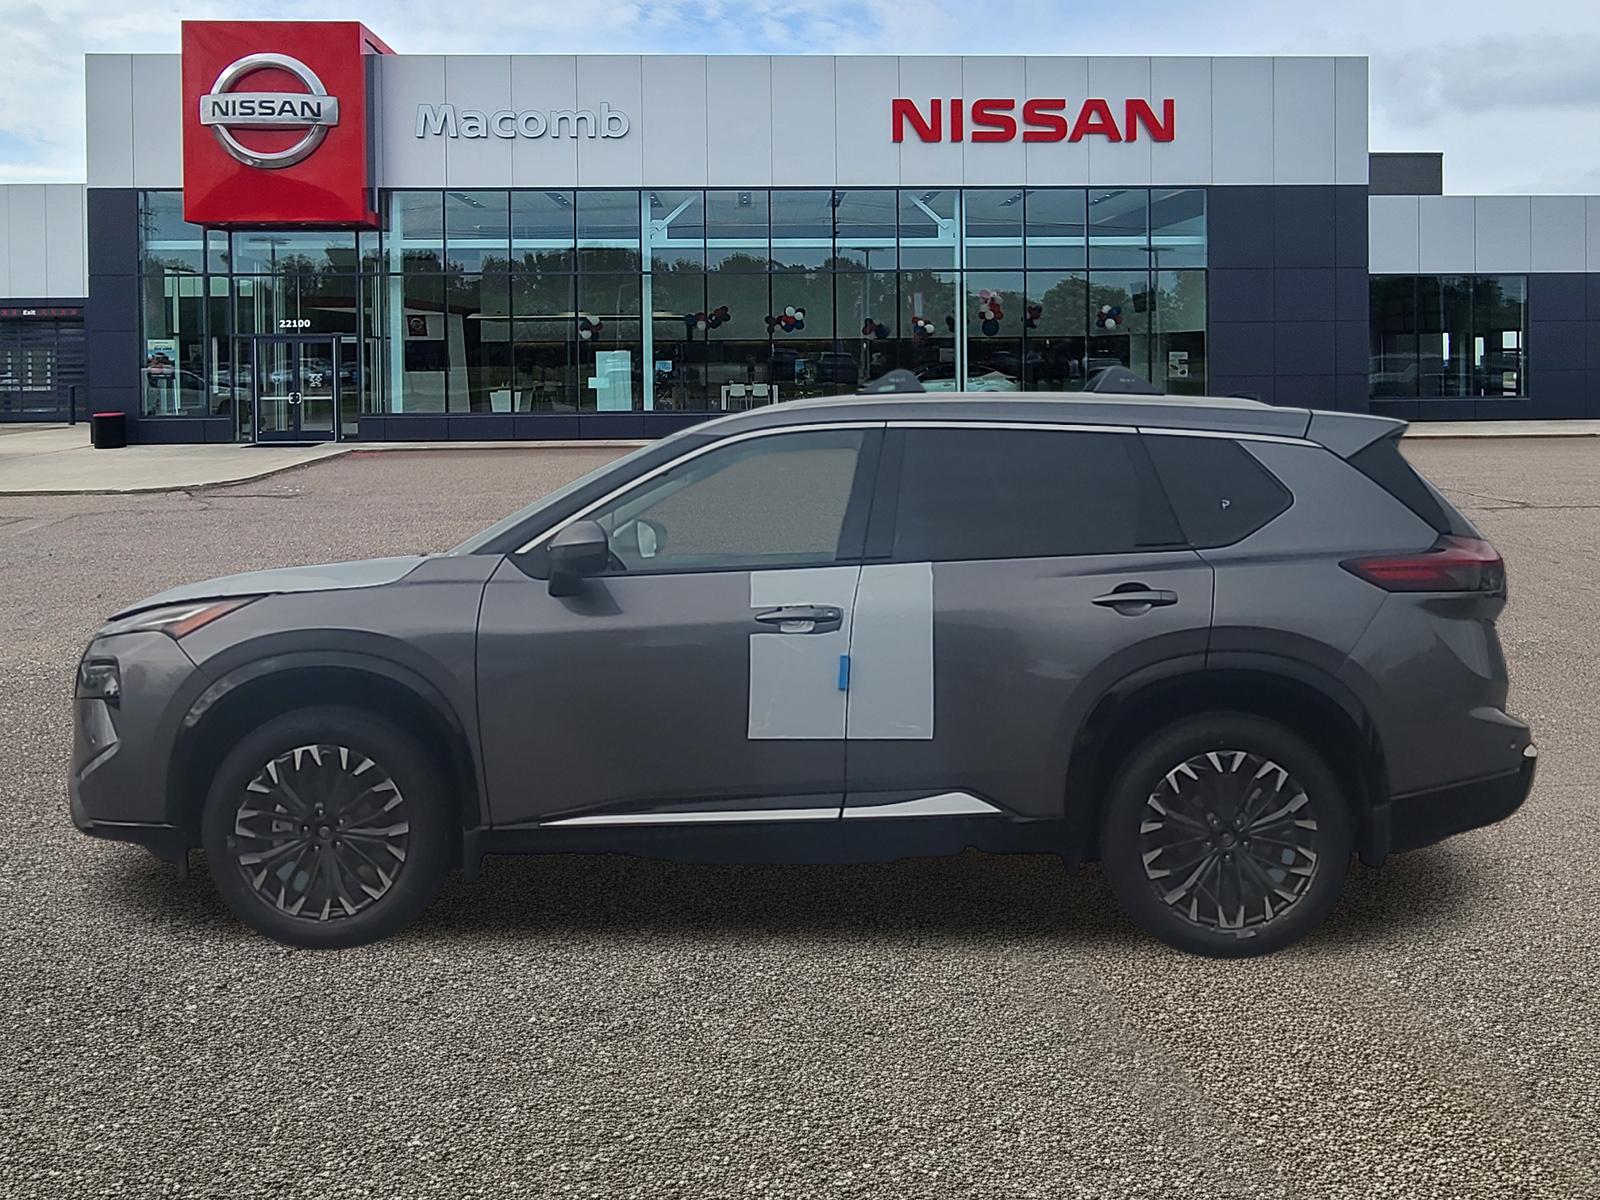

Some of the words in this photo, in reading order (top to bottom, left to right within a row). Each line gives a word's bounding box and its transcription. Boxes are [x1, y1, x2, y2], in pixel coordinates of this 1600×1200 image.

[212, 100, 321, 118] NISSAN
[415, 102, 630, 138] Macomb
[891, 98, 1176, 143] NISSAN
[279, 319, 311, 328] 22100
